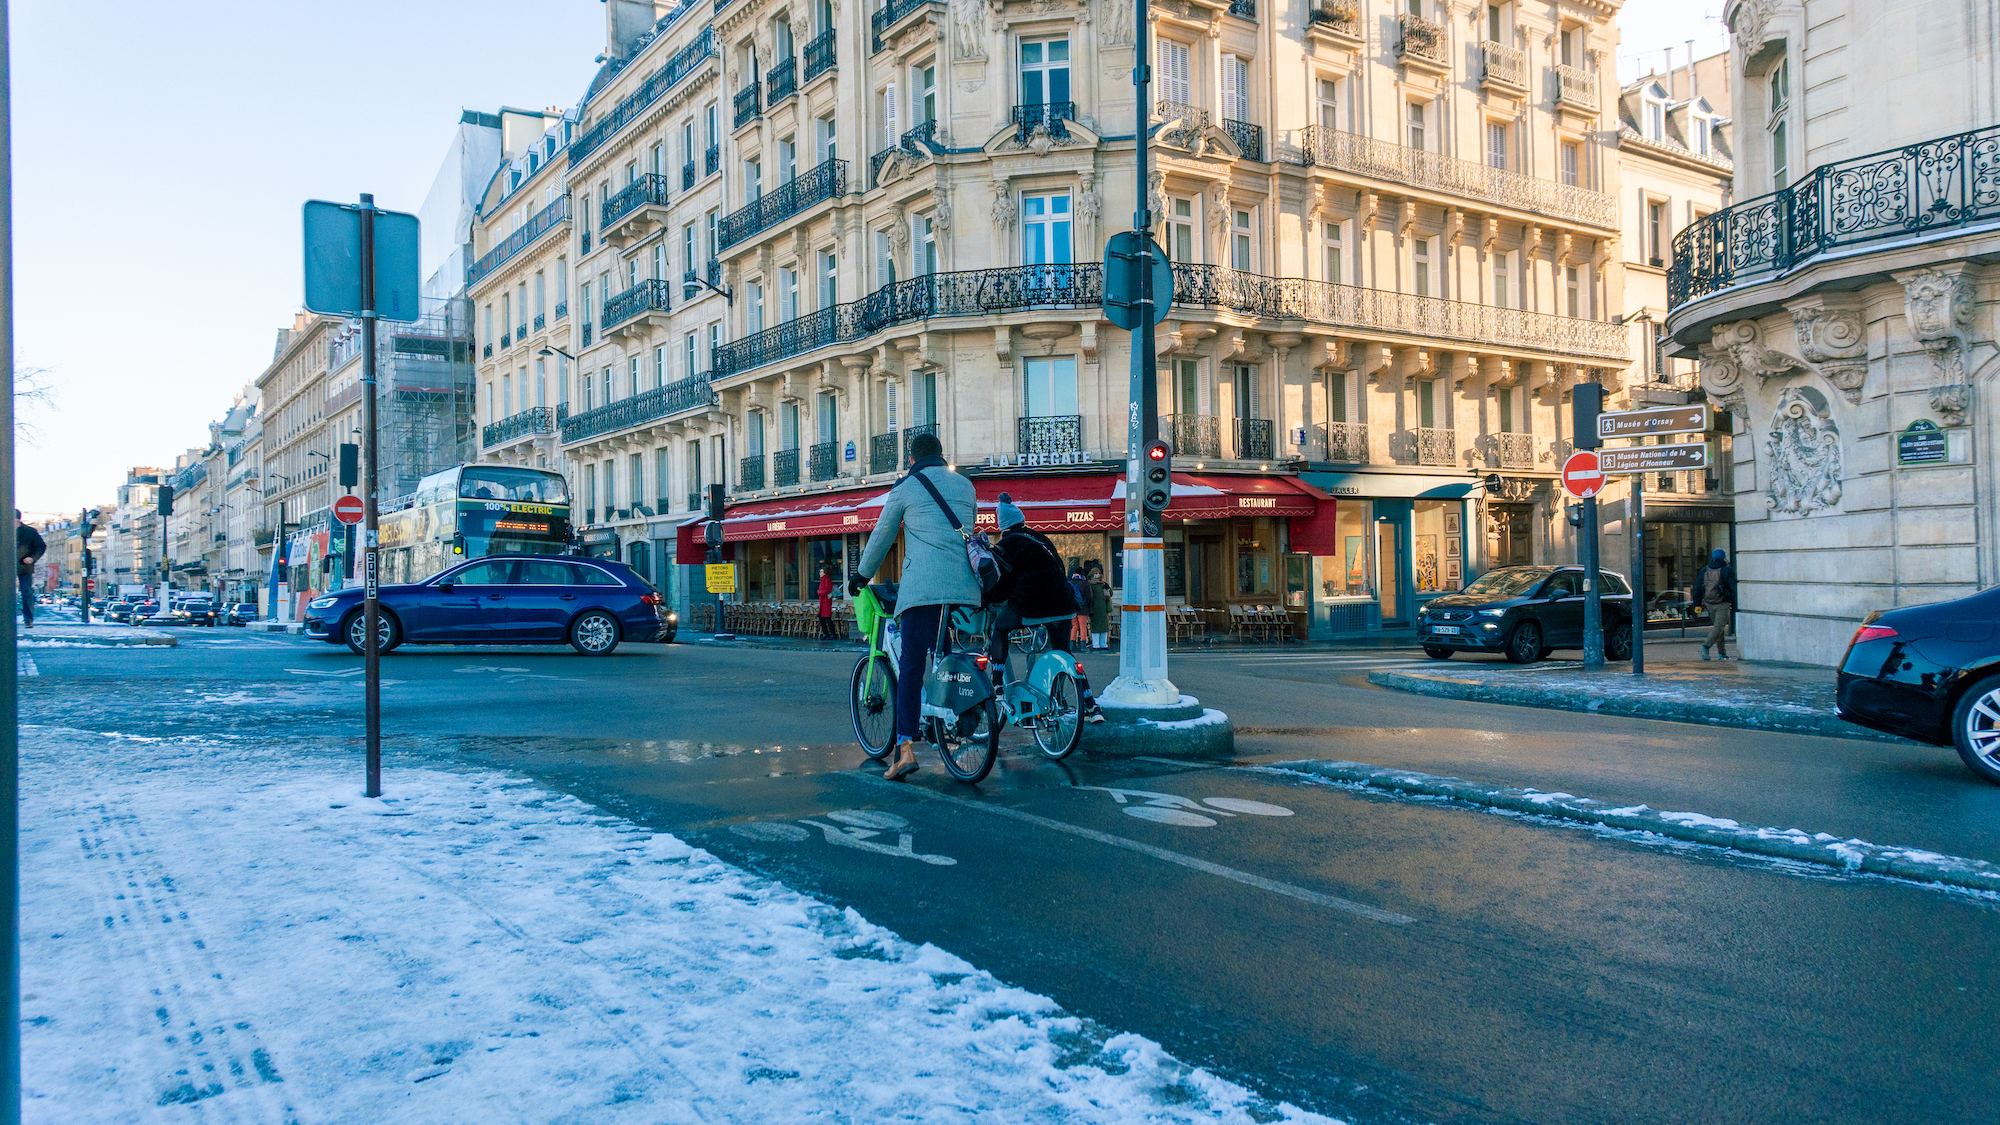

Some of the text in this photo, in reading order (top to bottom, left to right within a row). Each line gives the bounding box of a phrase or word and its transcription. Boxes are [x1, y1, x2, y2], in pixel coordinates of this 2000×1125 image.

[1616, 417, 1675, 429] Musée d'Orsay
[1616, 448, 1687, 460] Musée National de la
[989, 454, 1010, 467] LA
[1616, 459, 1675, 470] Légion d'Honneur
[1238, 497, 1277, 508] RESTAURANT
[484, 502, 553, 515] 100% ELECTRIC
[975, 513, 996, 524] EPES
[1066, 511, 1095, 522] PIZZAS
[367, 552, 376, 599] SONIC
[957, 673, 971, 682] Uber
[958, 687, 974, 697] Lime
